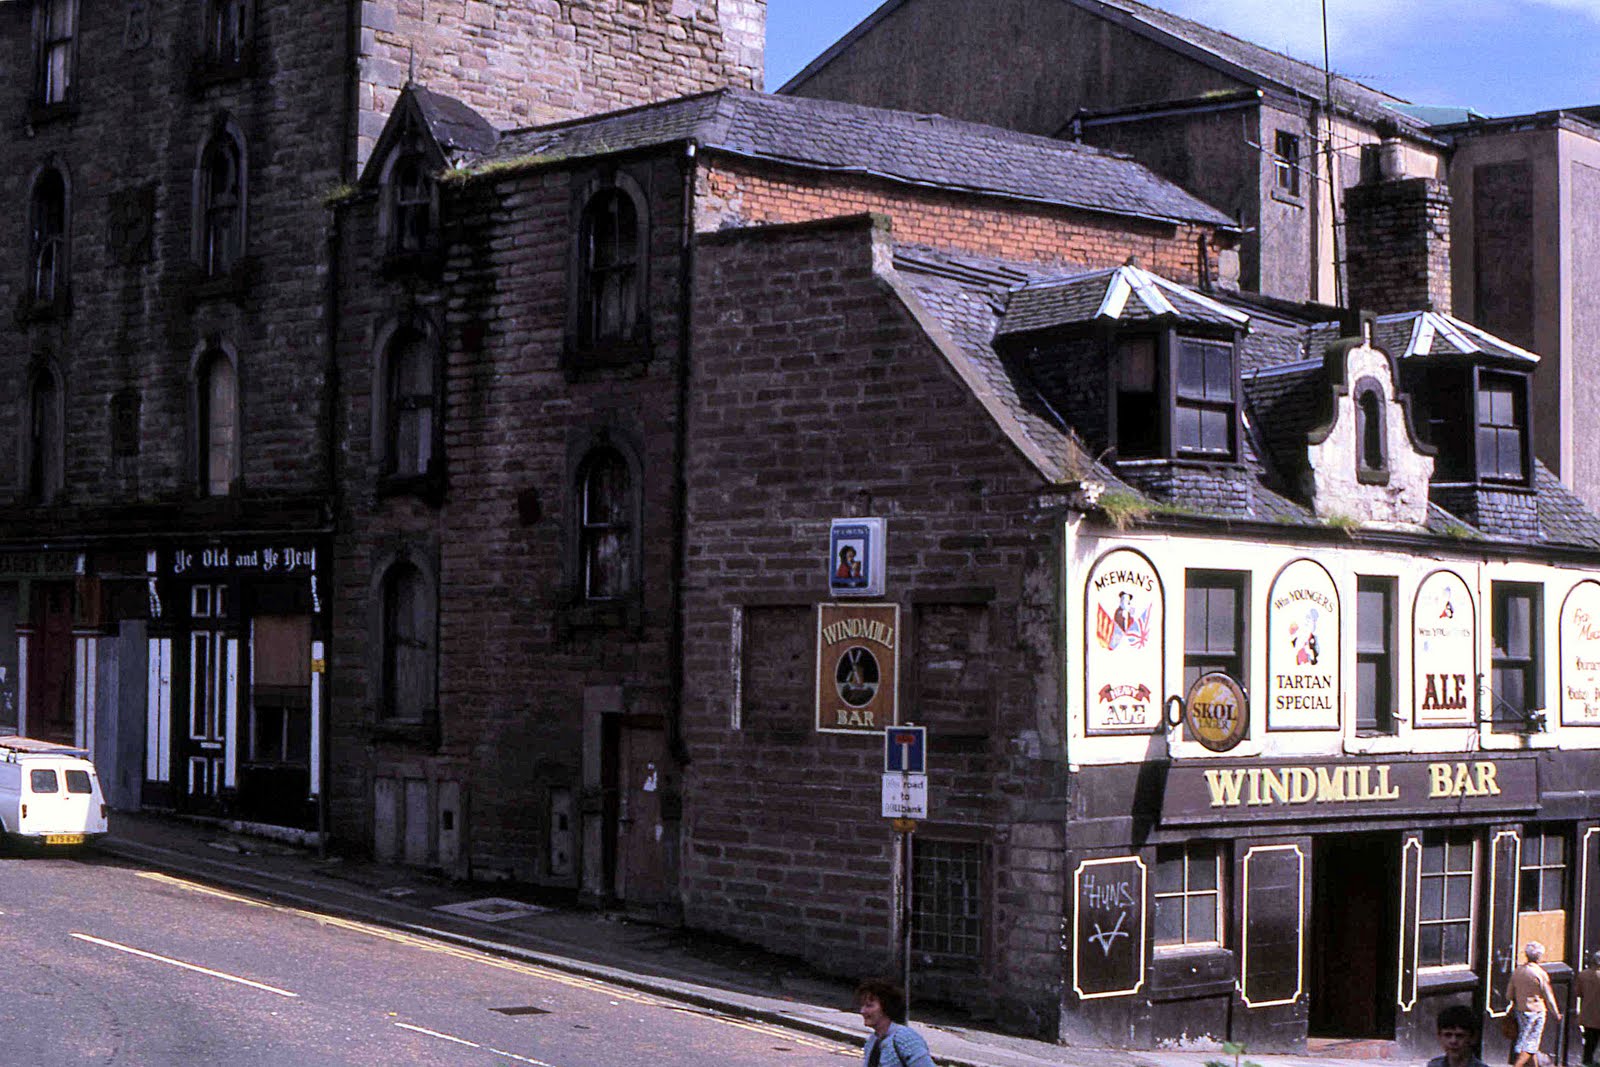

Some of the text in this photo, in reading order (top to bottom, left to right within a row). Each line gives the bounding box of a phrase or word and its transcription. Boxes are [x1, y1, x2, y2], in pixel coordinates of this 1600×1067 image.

[174, 550, 193, 574] Ye
[203, 547, 229, 567] Old
[235, 550, 258, 567] and
[822, 618, 894, 649] WINDMILL
[1276, 675, 1333, 689] TARTAN
[1421, 674, 1468, 711] ALE
[1192, 702, 1238, 721] SKOL
[1276, 695, 1333, 710] SPECIAL
[836, 709, 875, 727] BAR
[1101, 704, 1146, 725] ALE
[903, 781, 924, 790] road
[1204, 761, 1502, 808] WINDMILL BAR
[901, 792, 910, 801] to
